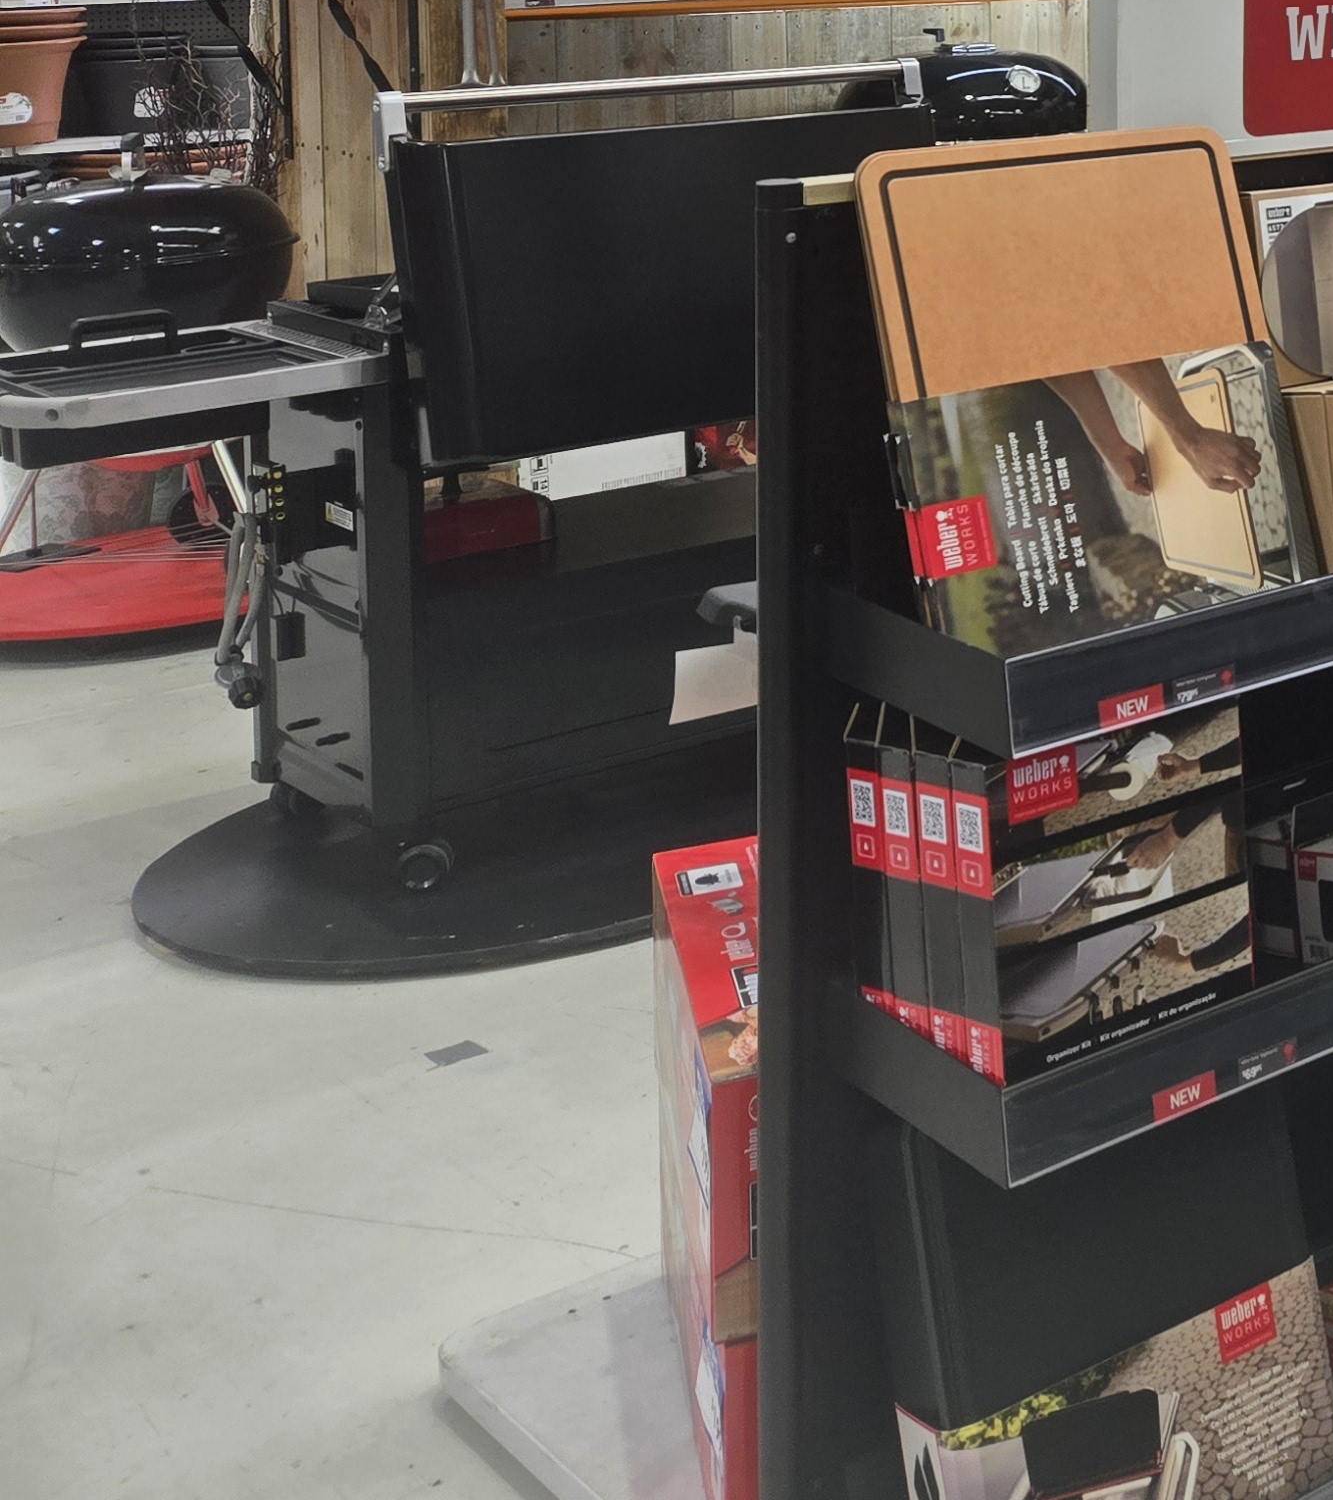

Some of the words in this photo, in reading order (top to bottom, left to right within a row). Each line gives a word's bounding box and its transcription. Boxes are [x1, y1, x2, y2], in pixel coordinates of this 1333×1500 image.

[1035, 420, 1051, 460] krojenia
[994, 444, 1008, 474] cortar
[1042, 462, 1052, 474] do
[1001, 475, 1014, 498] para
[1046, 476, 1058, 506] Deska
[1005, 500, 1017, 528] Tabla
[1018, 489, 1032, 528] Planche
[935, 519, 964, 572] weber
[955, 502, 979, 566] WORKS
[1012, 540, 1025, 570] Board
[1020, 571, 1033, 607] Cutting
[1115, 695, 1149, 719] NEW
[1012, 757, 1058, 788] weber
[1013, 777, 1073, 804] WORKS
[1046, 1041, 1081, 1063] Organizer
[1081, 1039, 1092, 1050] Kit
[1100, 1030, 1111, 1042] Kit
[1111, 1016, 1152, 1040] organizador
[1158, 1009, 1169, 1021] Kit
[1168, 1007, 1178, 1016] de
[1169, 1083, 1201, 1109] NEW
[1220, 1293, 1259, 1329] weber
[1222, 1311, 1272, 1346] WORKS
